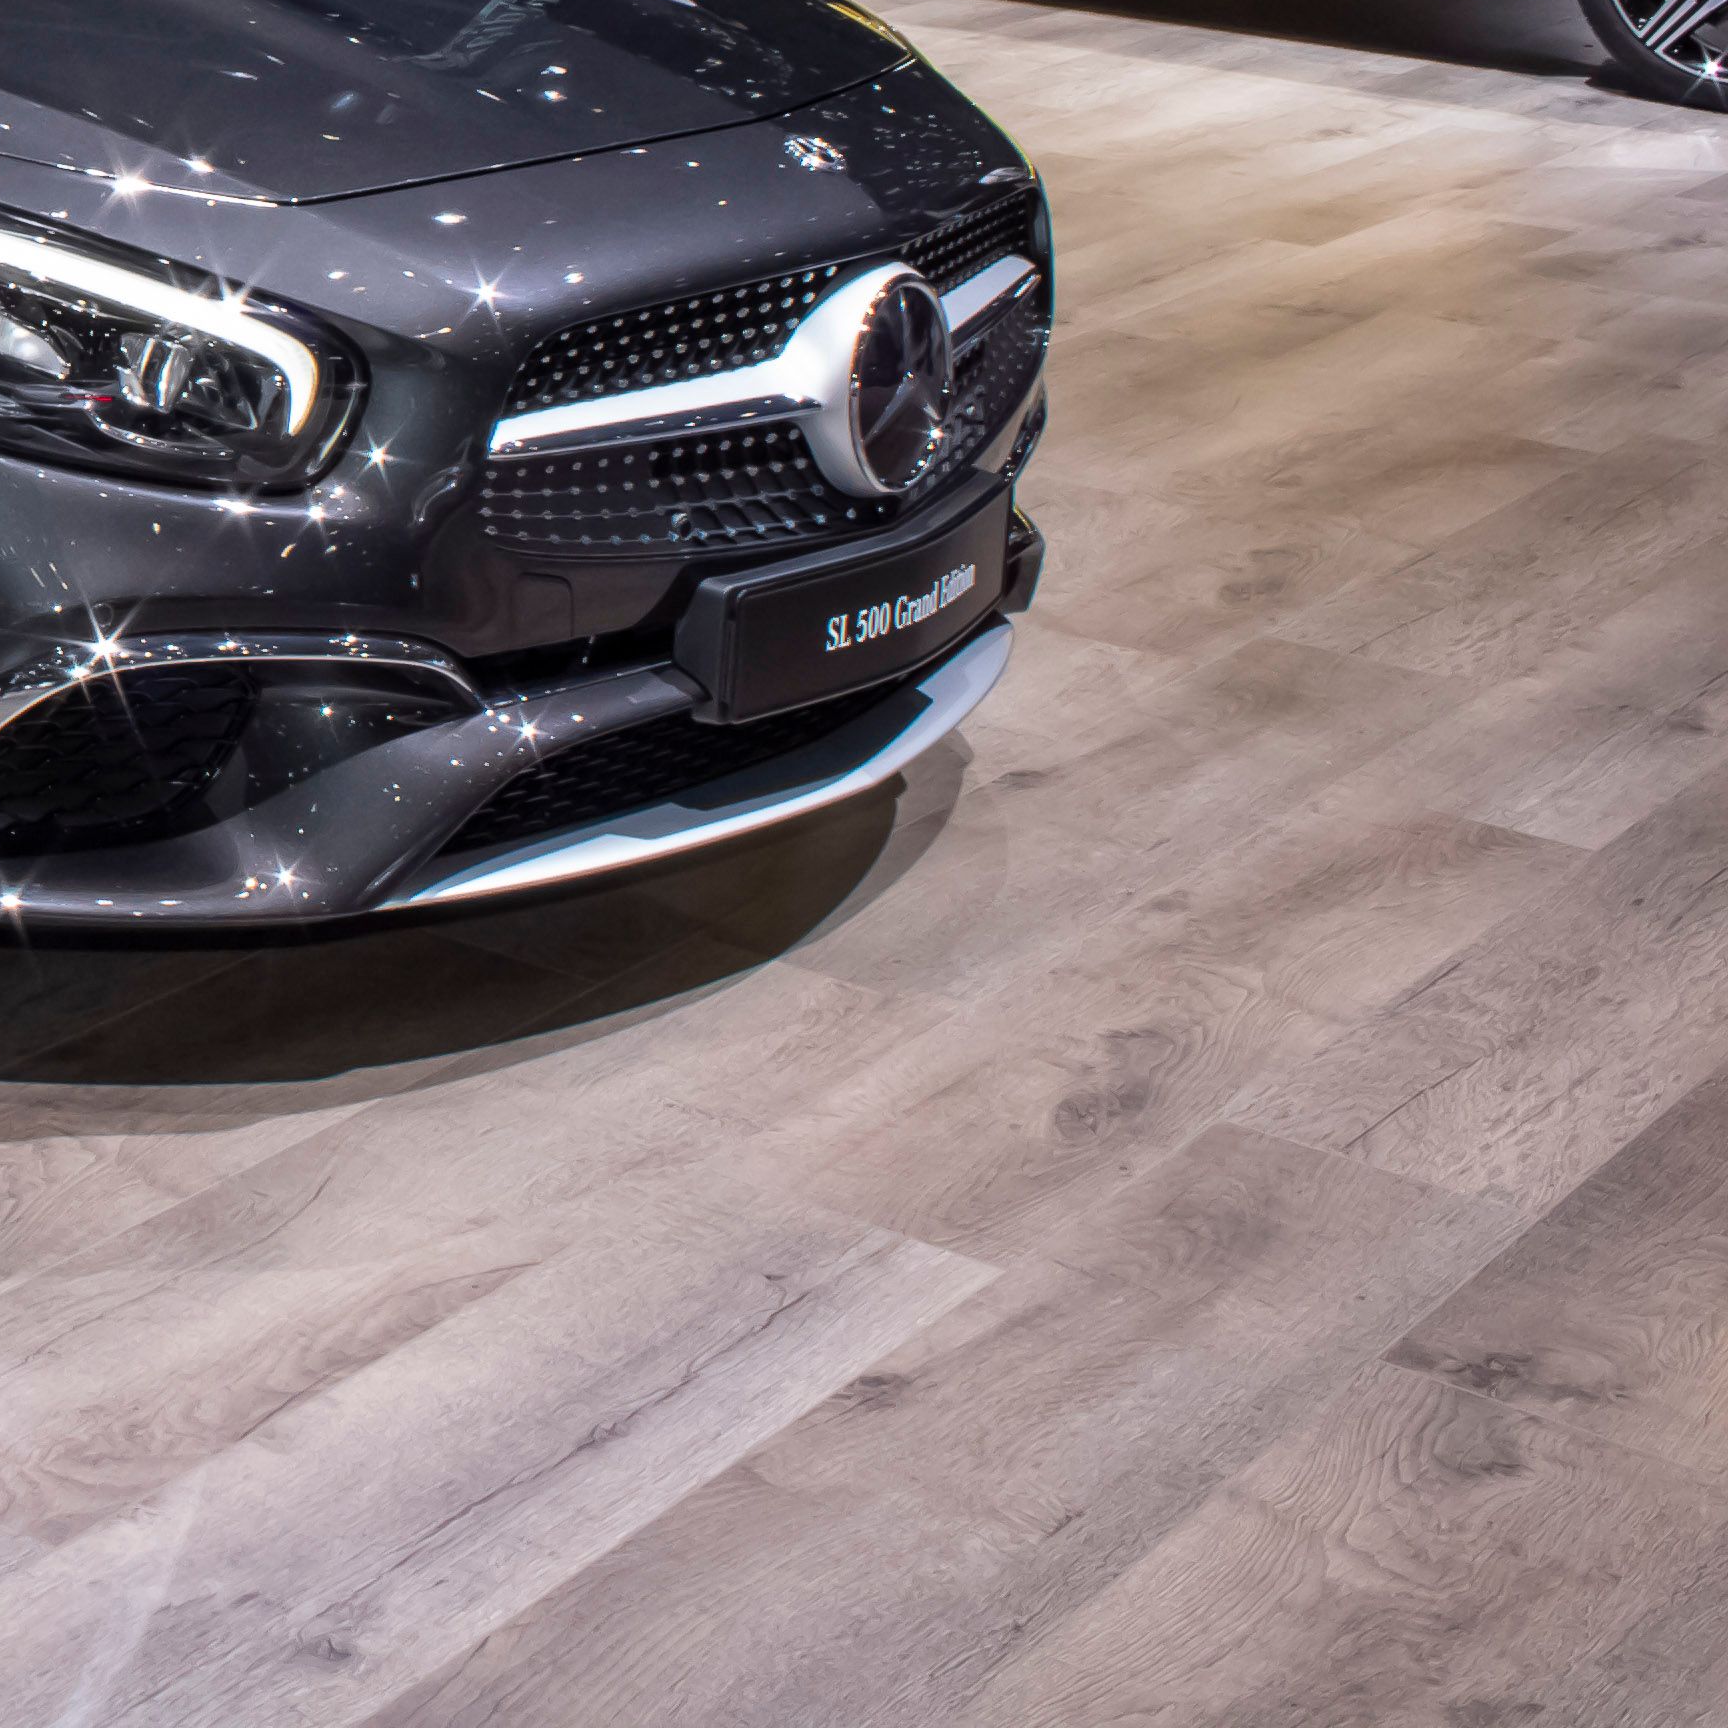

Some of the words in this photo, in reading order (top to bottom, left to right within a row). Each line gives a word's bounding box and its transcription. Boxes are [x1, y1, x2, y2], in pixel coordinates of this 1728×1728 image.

[825, 613, 852, 652] SL
[856, 602, 892, 643] 500
[895, 581, 939, 629] Grand
[939, 563, 976, 608] Edition
